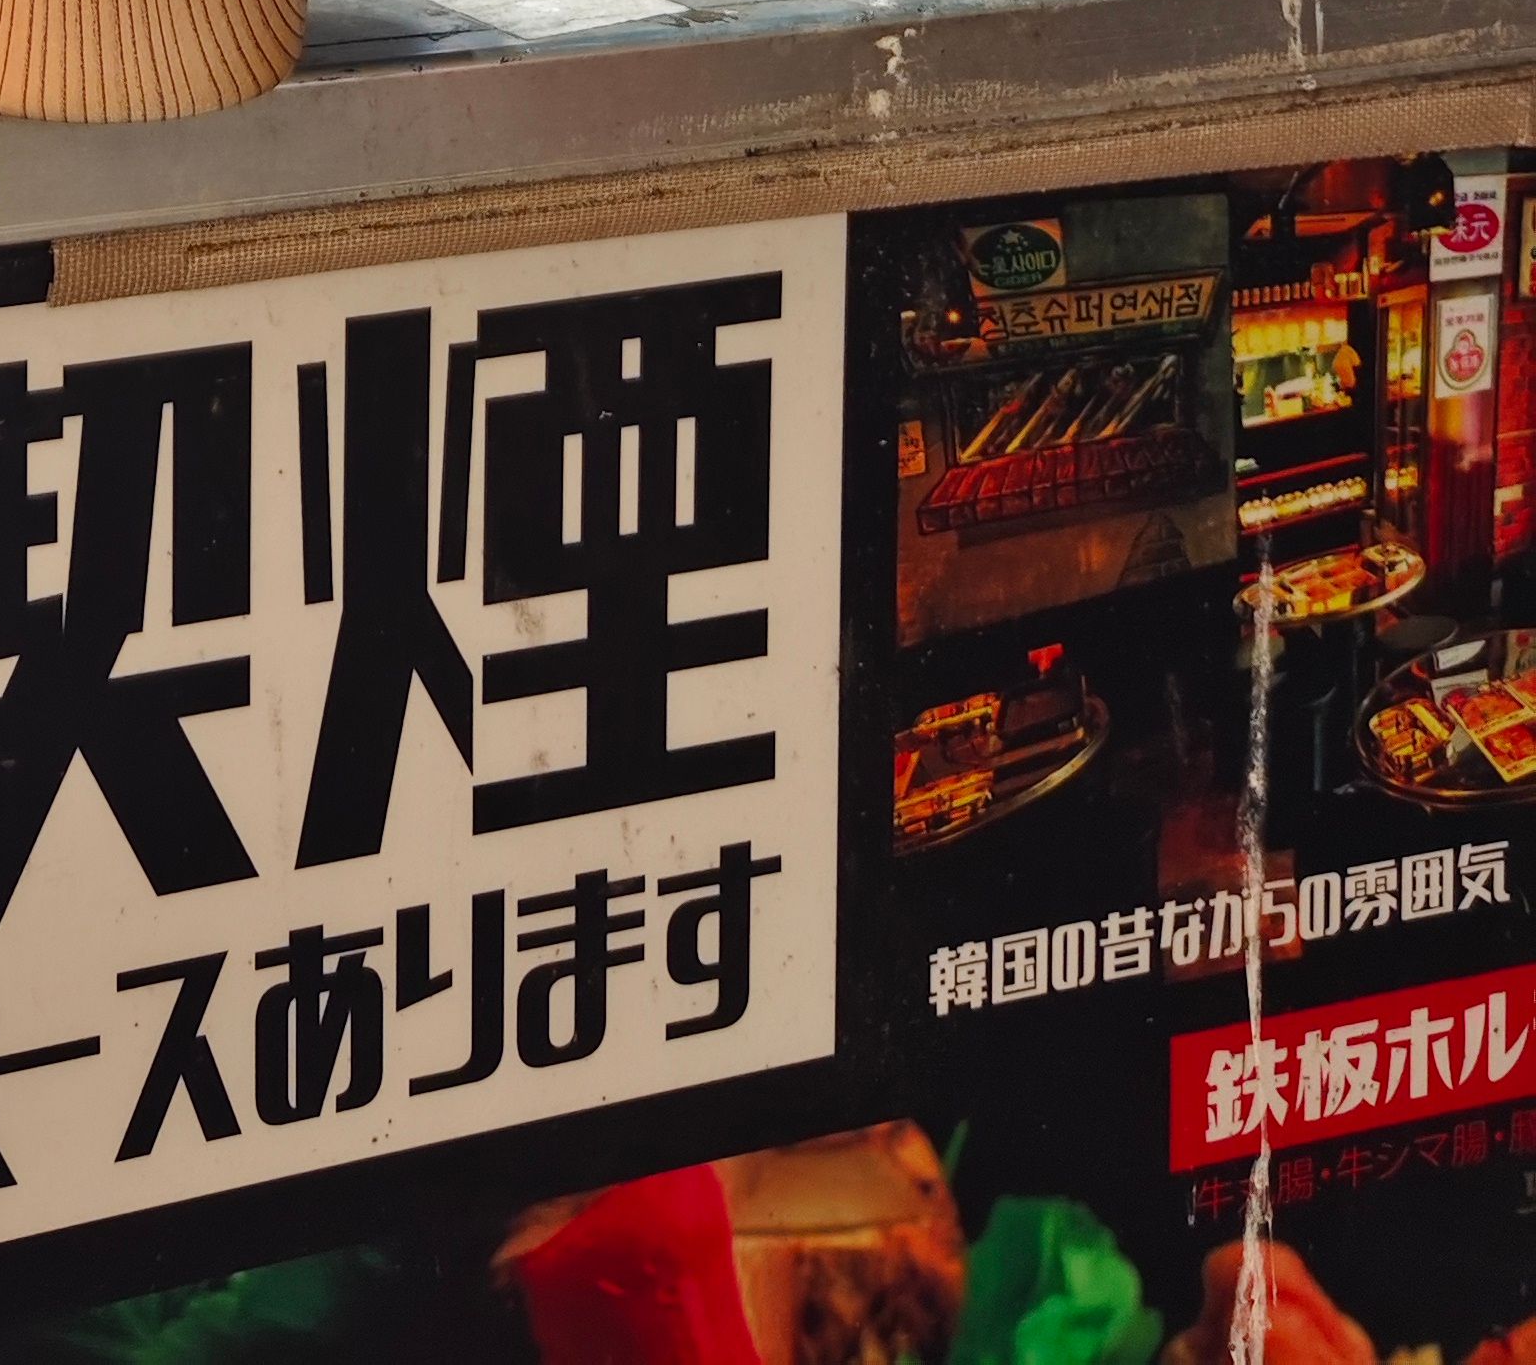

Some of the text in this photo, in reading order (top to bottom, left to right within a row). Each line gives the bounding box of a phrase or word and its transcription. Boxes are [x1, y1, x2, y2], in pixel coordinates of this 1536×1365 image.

[928, 840, 1511, 1017] 韓国の昔ながらの雰囲気
[1204, 990, 1536, 1144] 鉄板ホル
